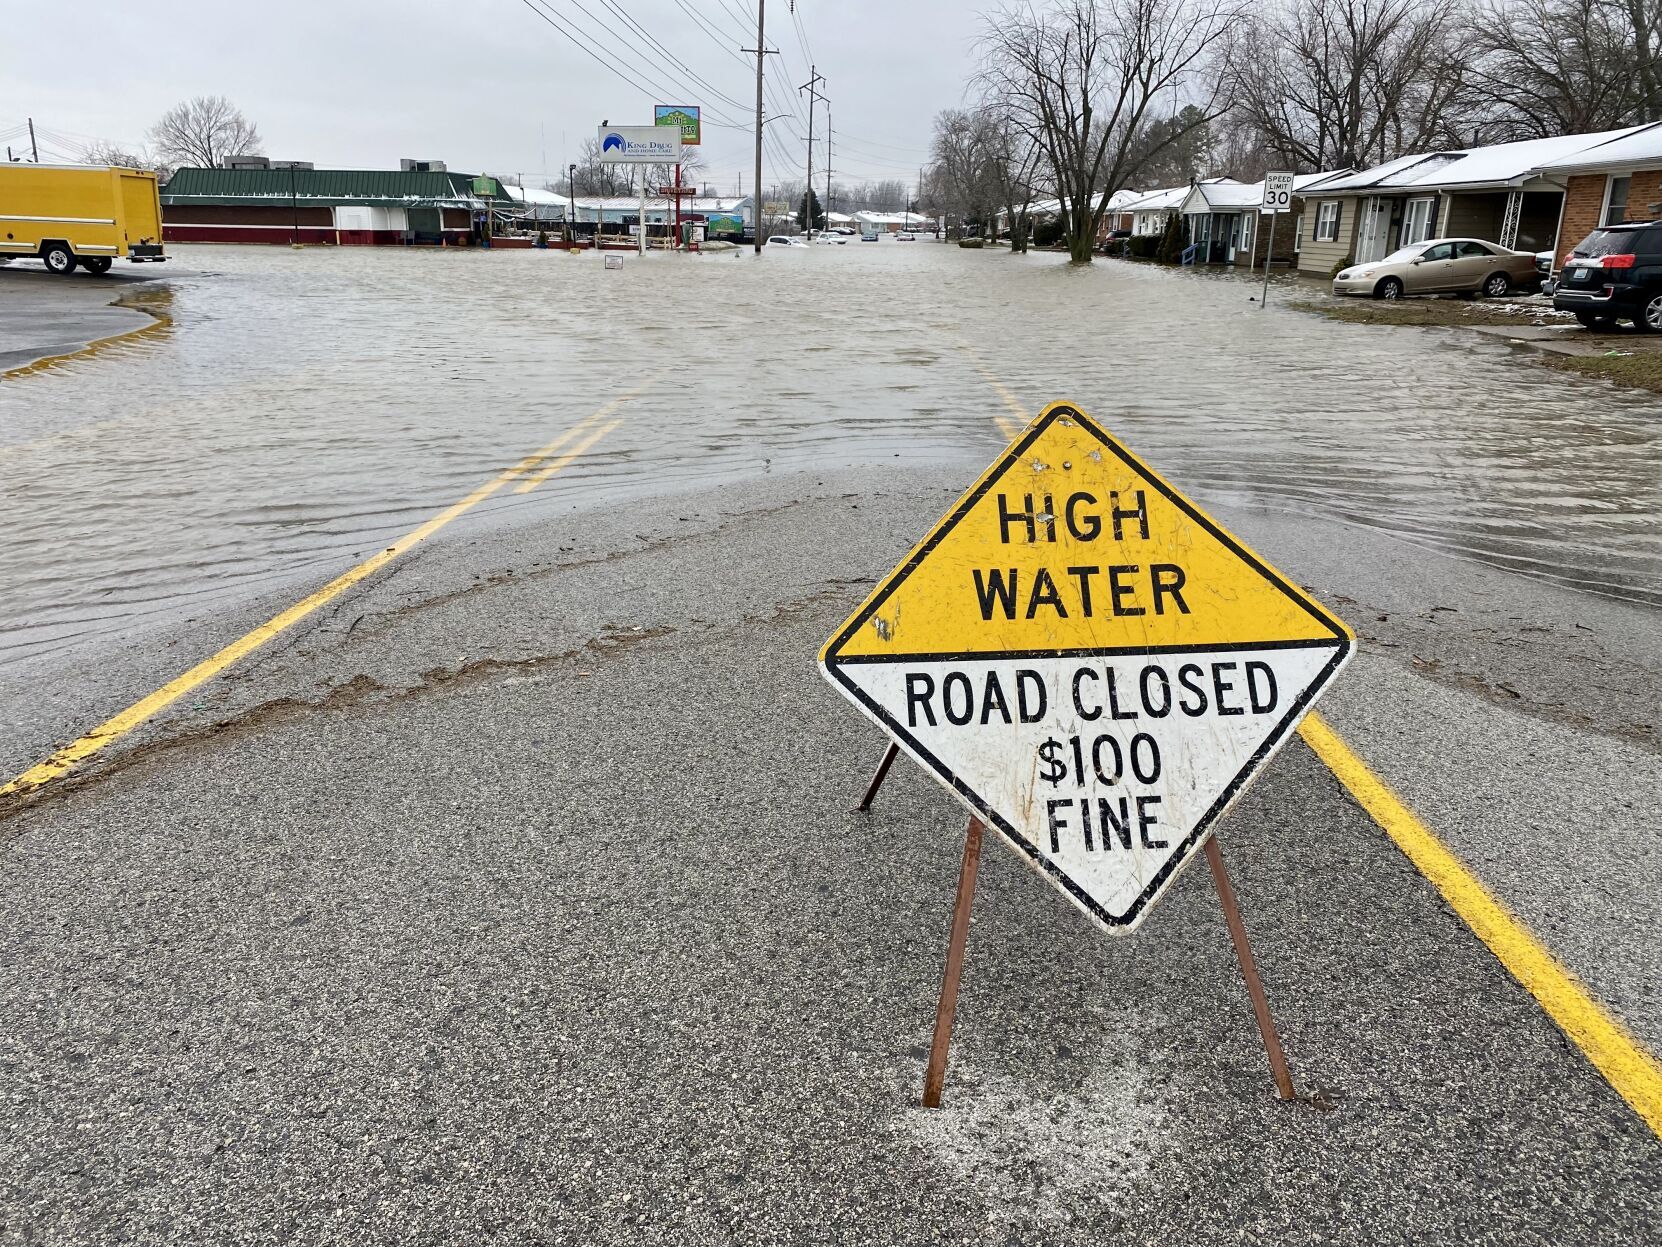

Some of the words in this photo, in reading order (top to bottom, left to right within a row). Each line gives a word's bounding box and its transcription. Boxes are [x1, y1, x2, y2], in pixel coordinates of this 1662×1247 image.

[1266, 191, 1289, 205] 30
[997, 490, 1151, 543] HIGH
[973, 563, 1191, 620] WATER
[905, 669, 1047, 727] ROAD
[1072, 660, 1278, 720] CLOSED
[1038, 732, 1162, 788] $100
[1047, 795, 1168, 853] FINE
